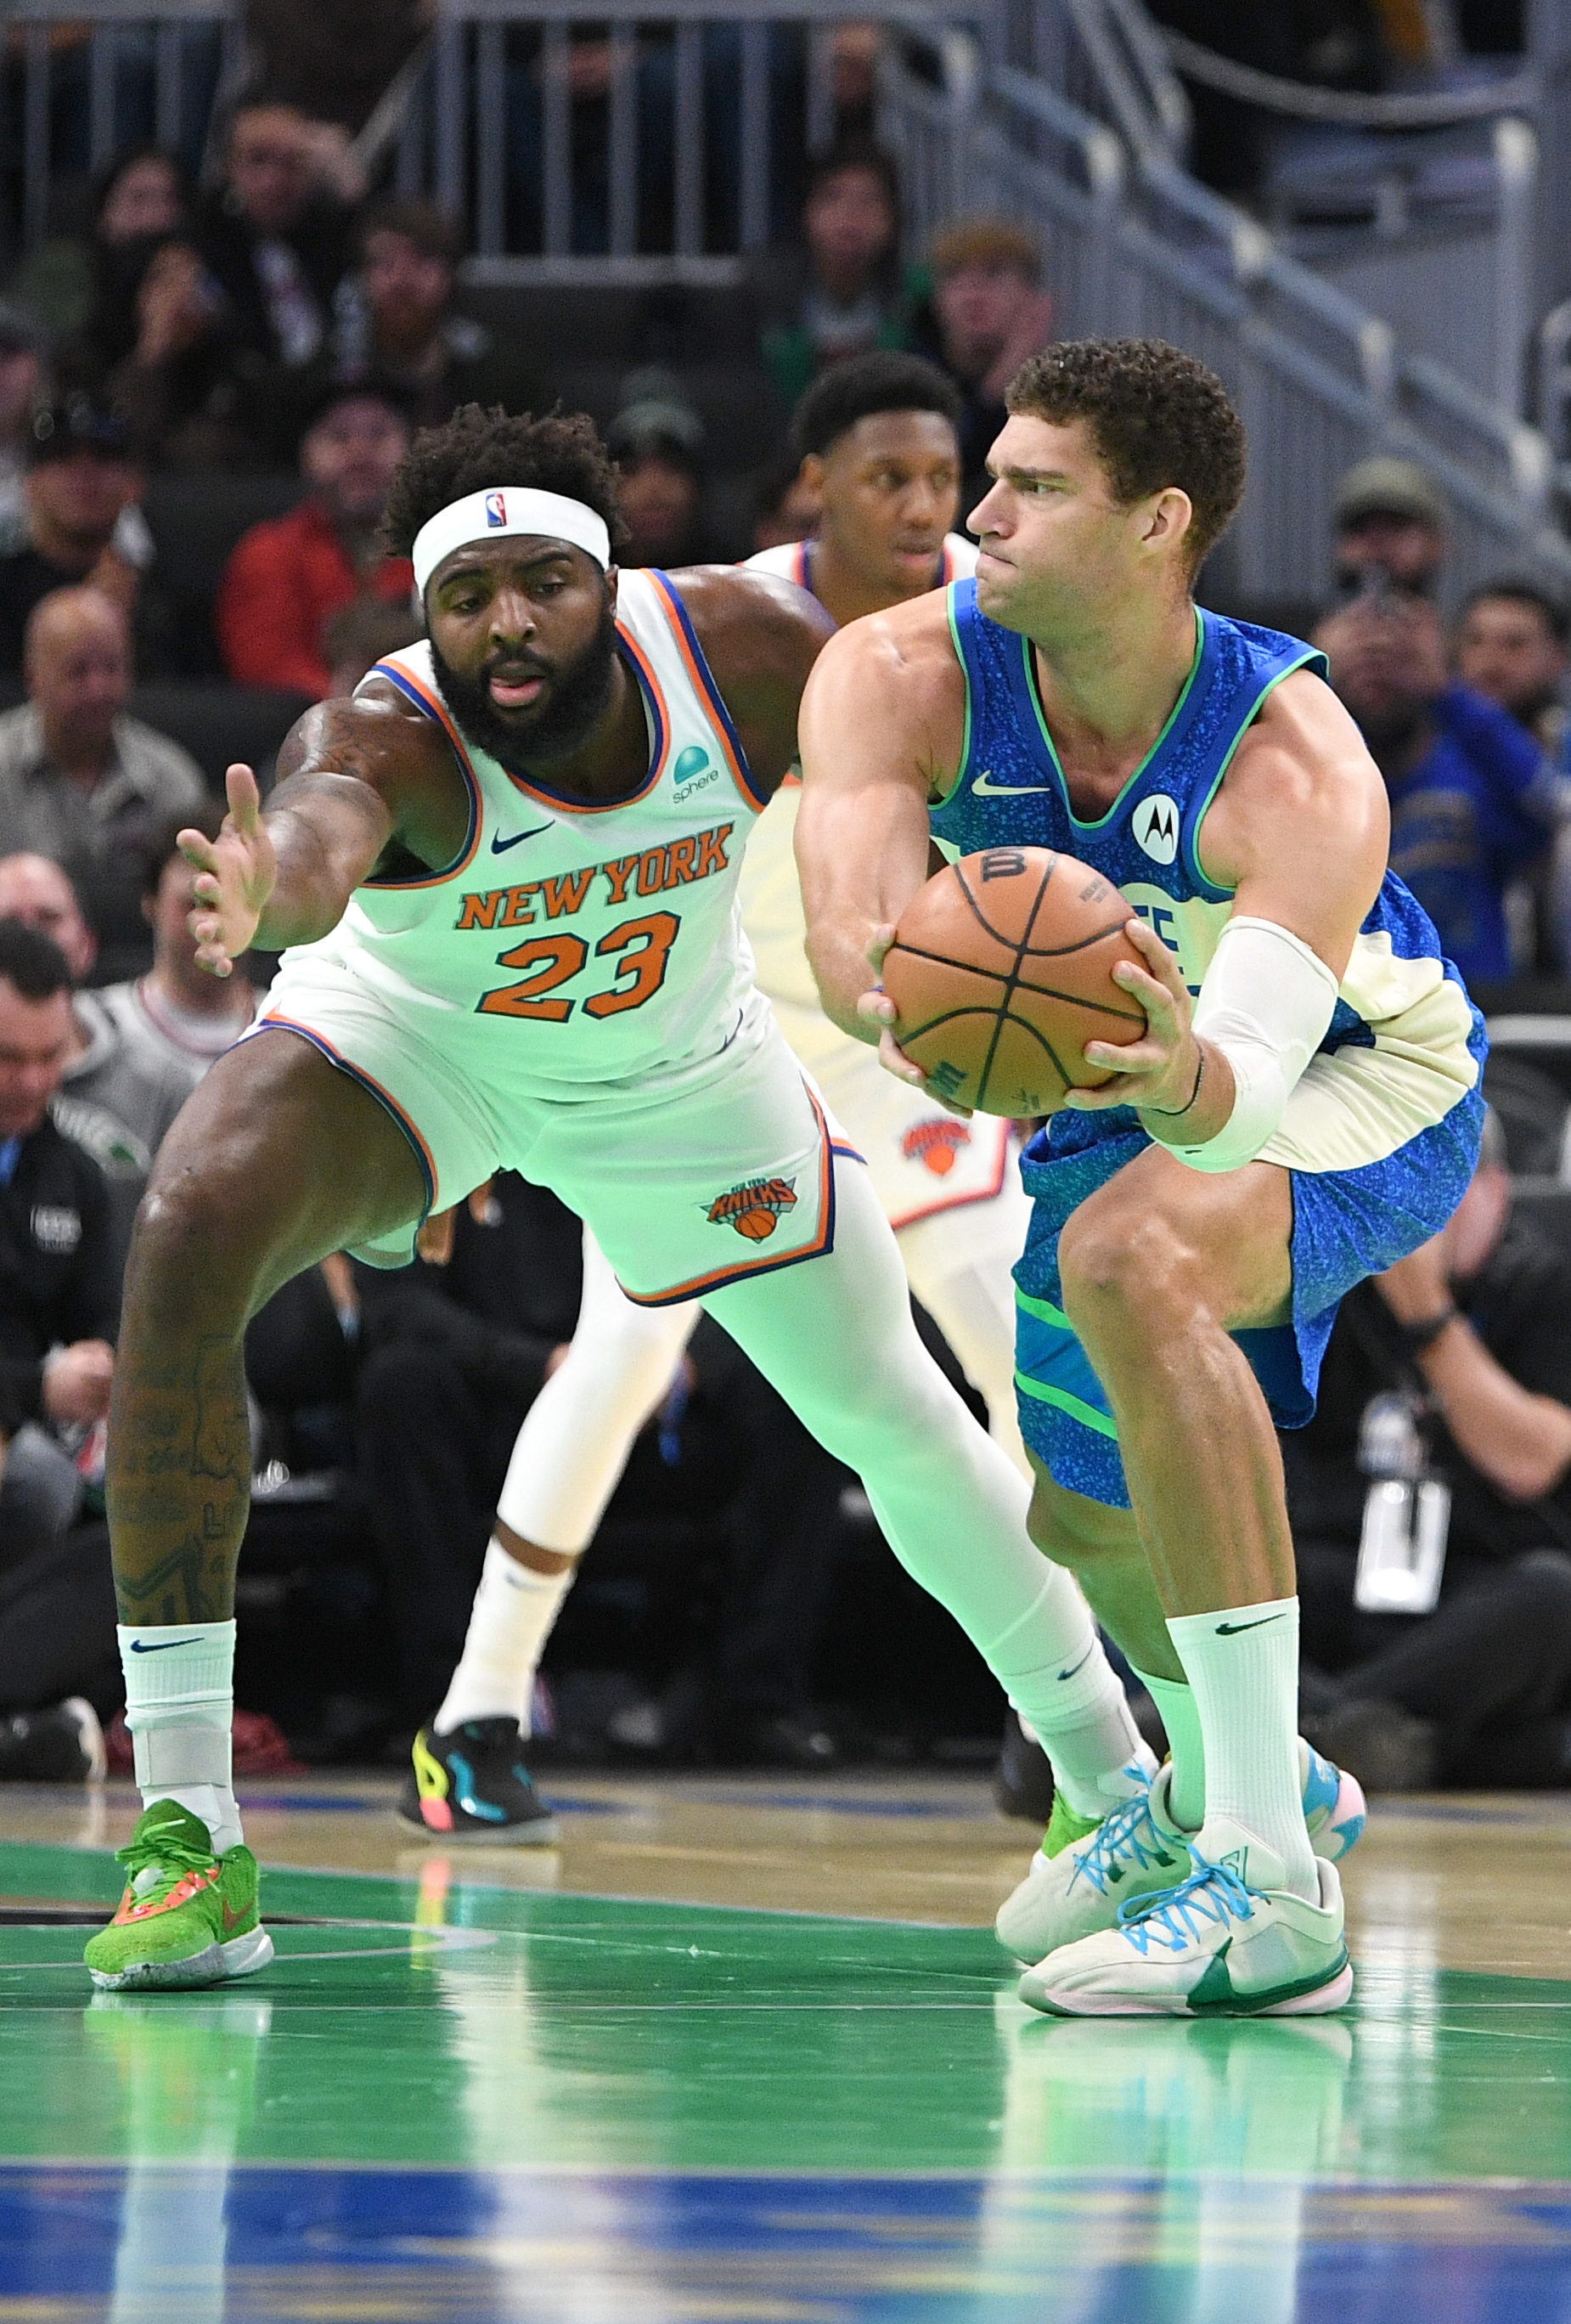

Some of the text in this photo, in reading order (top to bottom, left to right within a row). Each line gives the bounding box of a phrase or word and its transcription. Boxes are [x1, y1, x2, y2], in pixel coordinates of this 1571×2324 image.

[673, 770, 718, 804] sphere
[454, 821, 735, 930] NEW YORK
[474, 910, 682, 1024] 23
[707, 1178, 797, 1222] KNICKS
